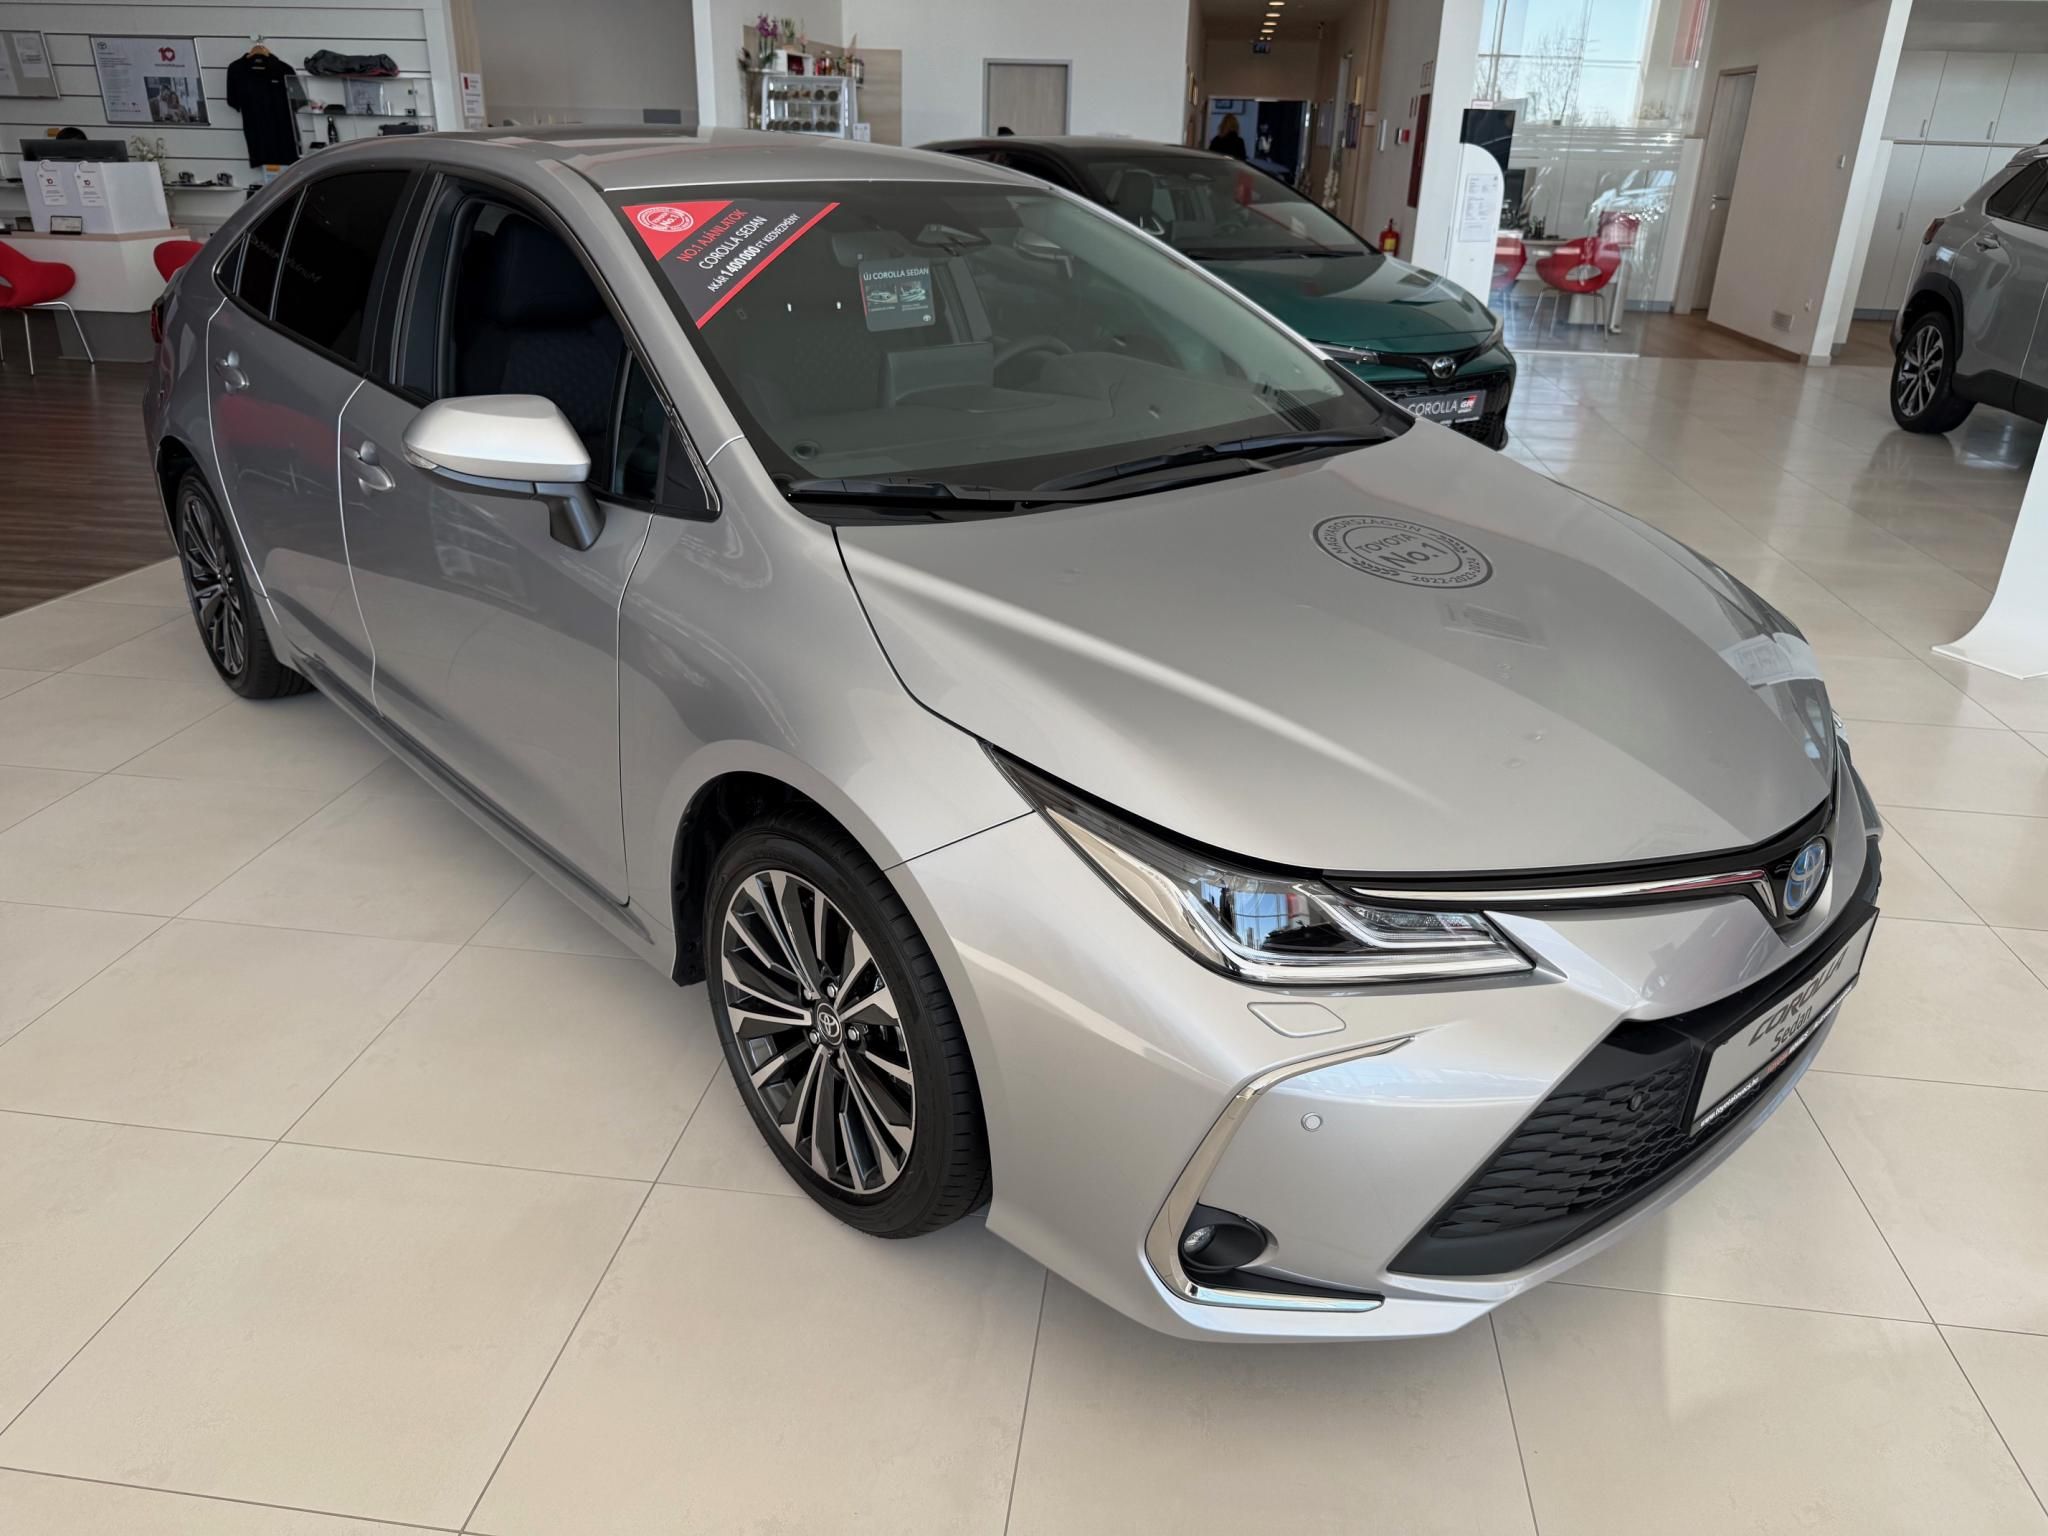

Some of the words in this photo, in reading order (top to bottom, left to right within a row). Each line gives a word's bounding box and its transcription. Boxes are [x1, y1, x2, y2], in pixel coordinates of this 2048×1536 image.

[676, 244, 704, 262] NO.1
[699, 236, 744, 269] COROLLA
[735, 216, 768, 239] SEDAN
[707, 275, 729, 292] AKÁR
[872, 269, 906, 280] COROLLA
[905, 267, 929, 277] SEDAN
[1407, 400, 1457, 416] COROLLA
[1355, 533, 1418, 554] TOYOTA
[1378, 542, 1449, 569] No.1
[1748, 946, 1850, 1047] COROLLA
[1770, 1006, 1813, 1052] Sedan
